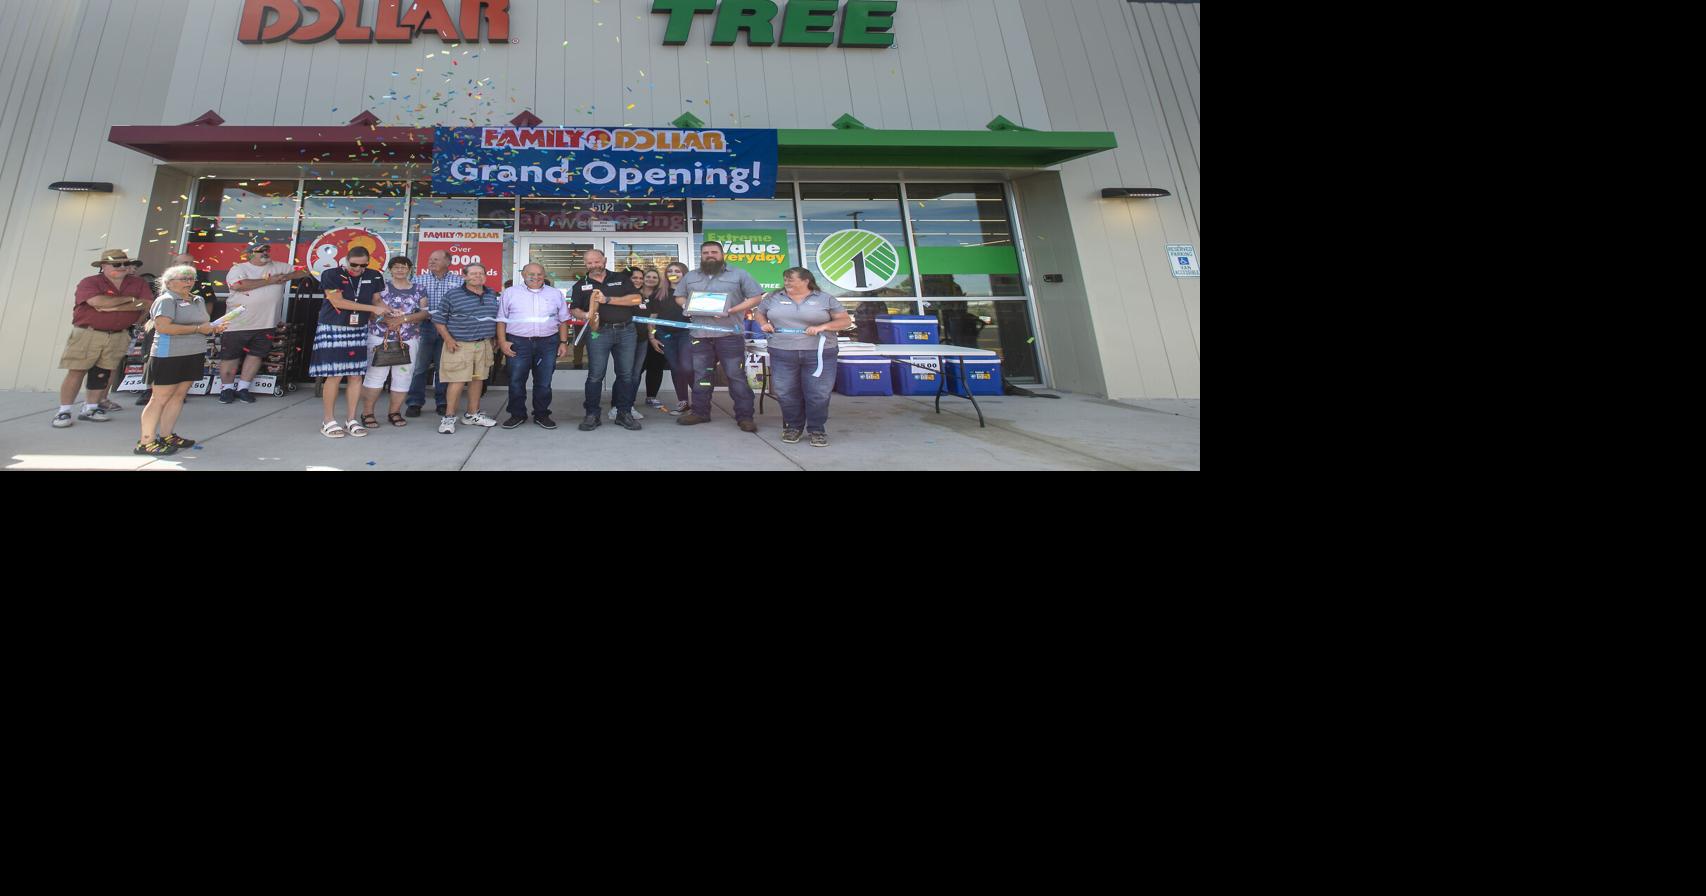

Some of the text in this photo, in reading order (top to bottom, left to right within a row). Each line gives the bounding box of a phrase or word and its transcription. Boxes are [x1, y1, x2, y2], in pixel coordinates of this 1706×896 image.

[237, 0, 510, 44] DOLLAR
[651, 0, 897, 48] TREE
[483, 128, 725, 151] FAMILY DOLLAR
[450, 157, 761, 194] Grand Opening!
[423, 231, 455, 239] FAMILY
[707, 232, 772, 242] Extreme
[717, 240, 780, 254] Value
[451, 255, 481, 266] 000
[724, 252, 786, 264] veryday
